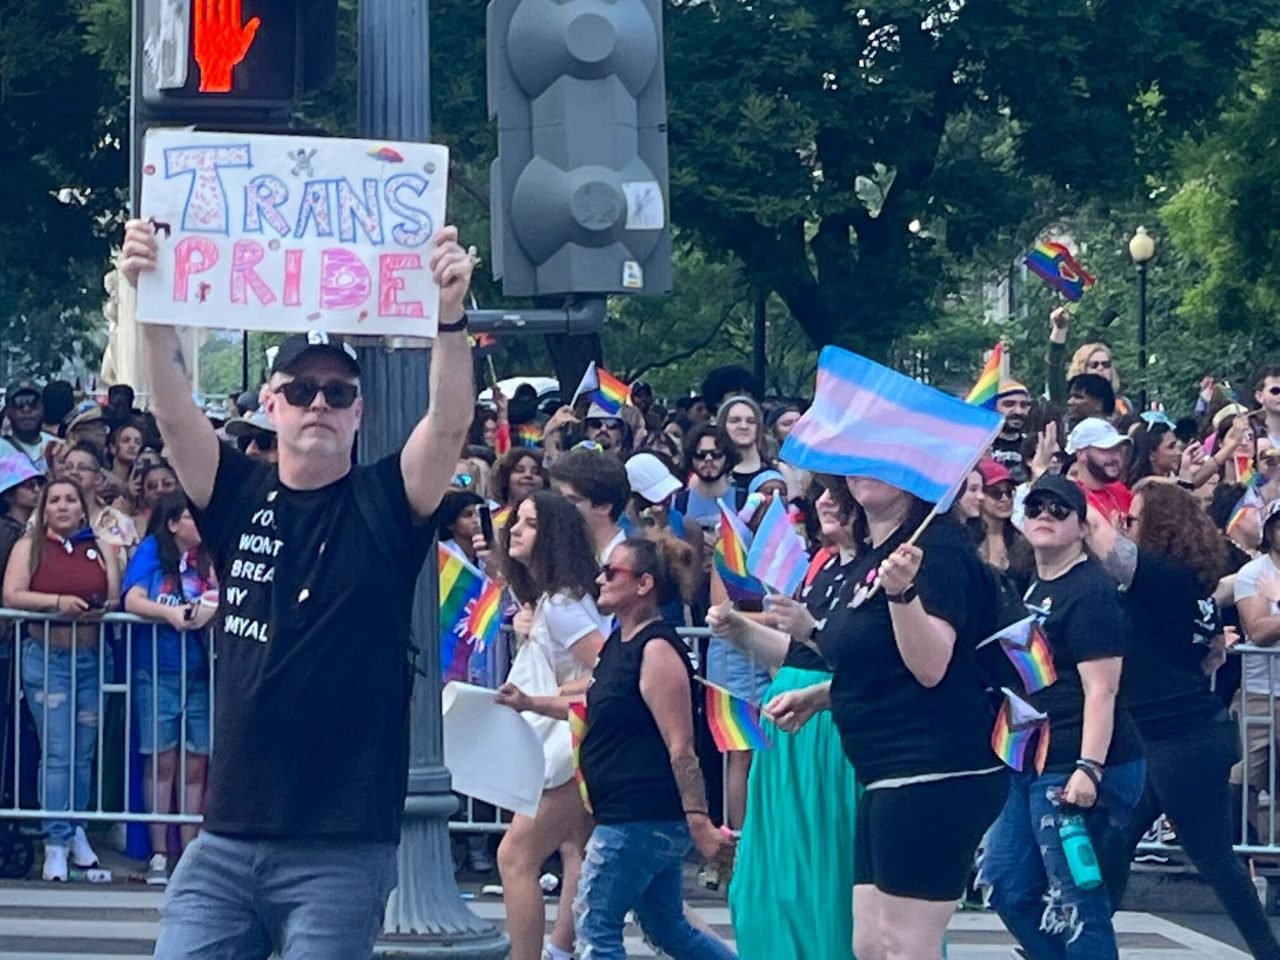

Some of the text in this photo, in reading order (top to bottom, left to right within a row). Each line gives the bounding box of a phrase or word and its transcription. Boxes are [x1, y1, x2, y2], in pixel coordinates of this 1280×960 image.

[163, 143, 433, 248] TRANS
[172, 235, 430, 319] PRIDE
[238, 532, 284, 558] WONT
[230, 558, 276, 583] BREA
[223, 613, 269, 643] MYAL
